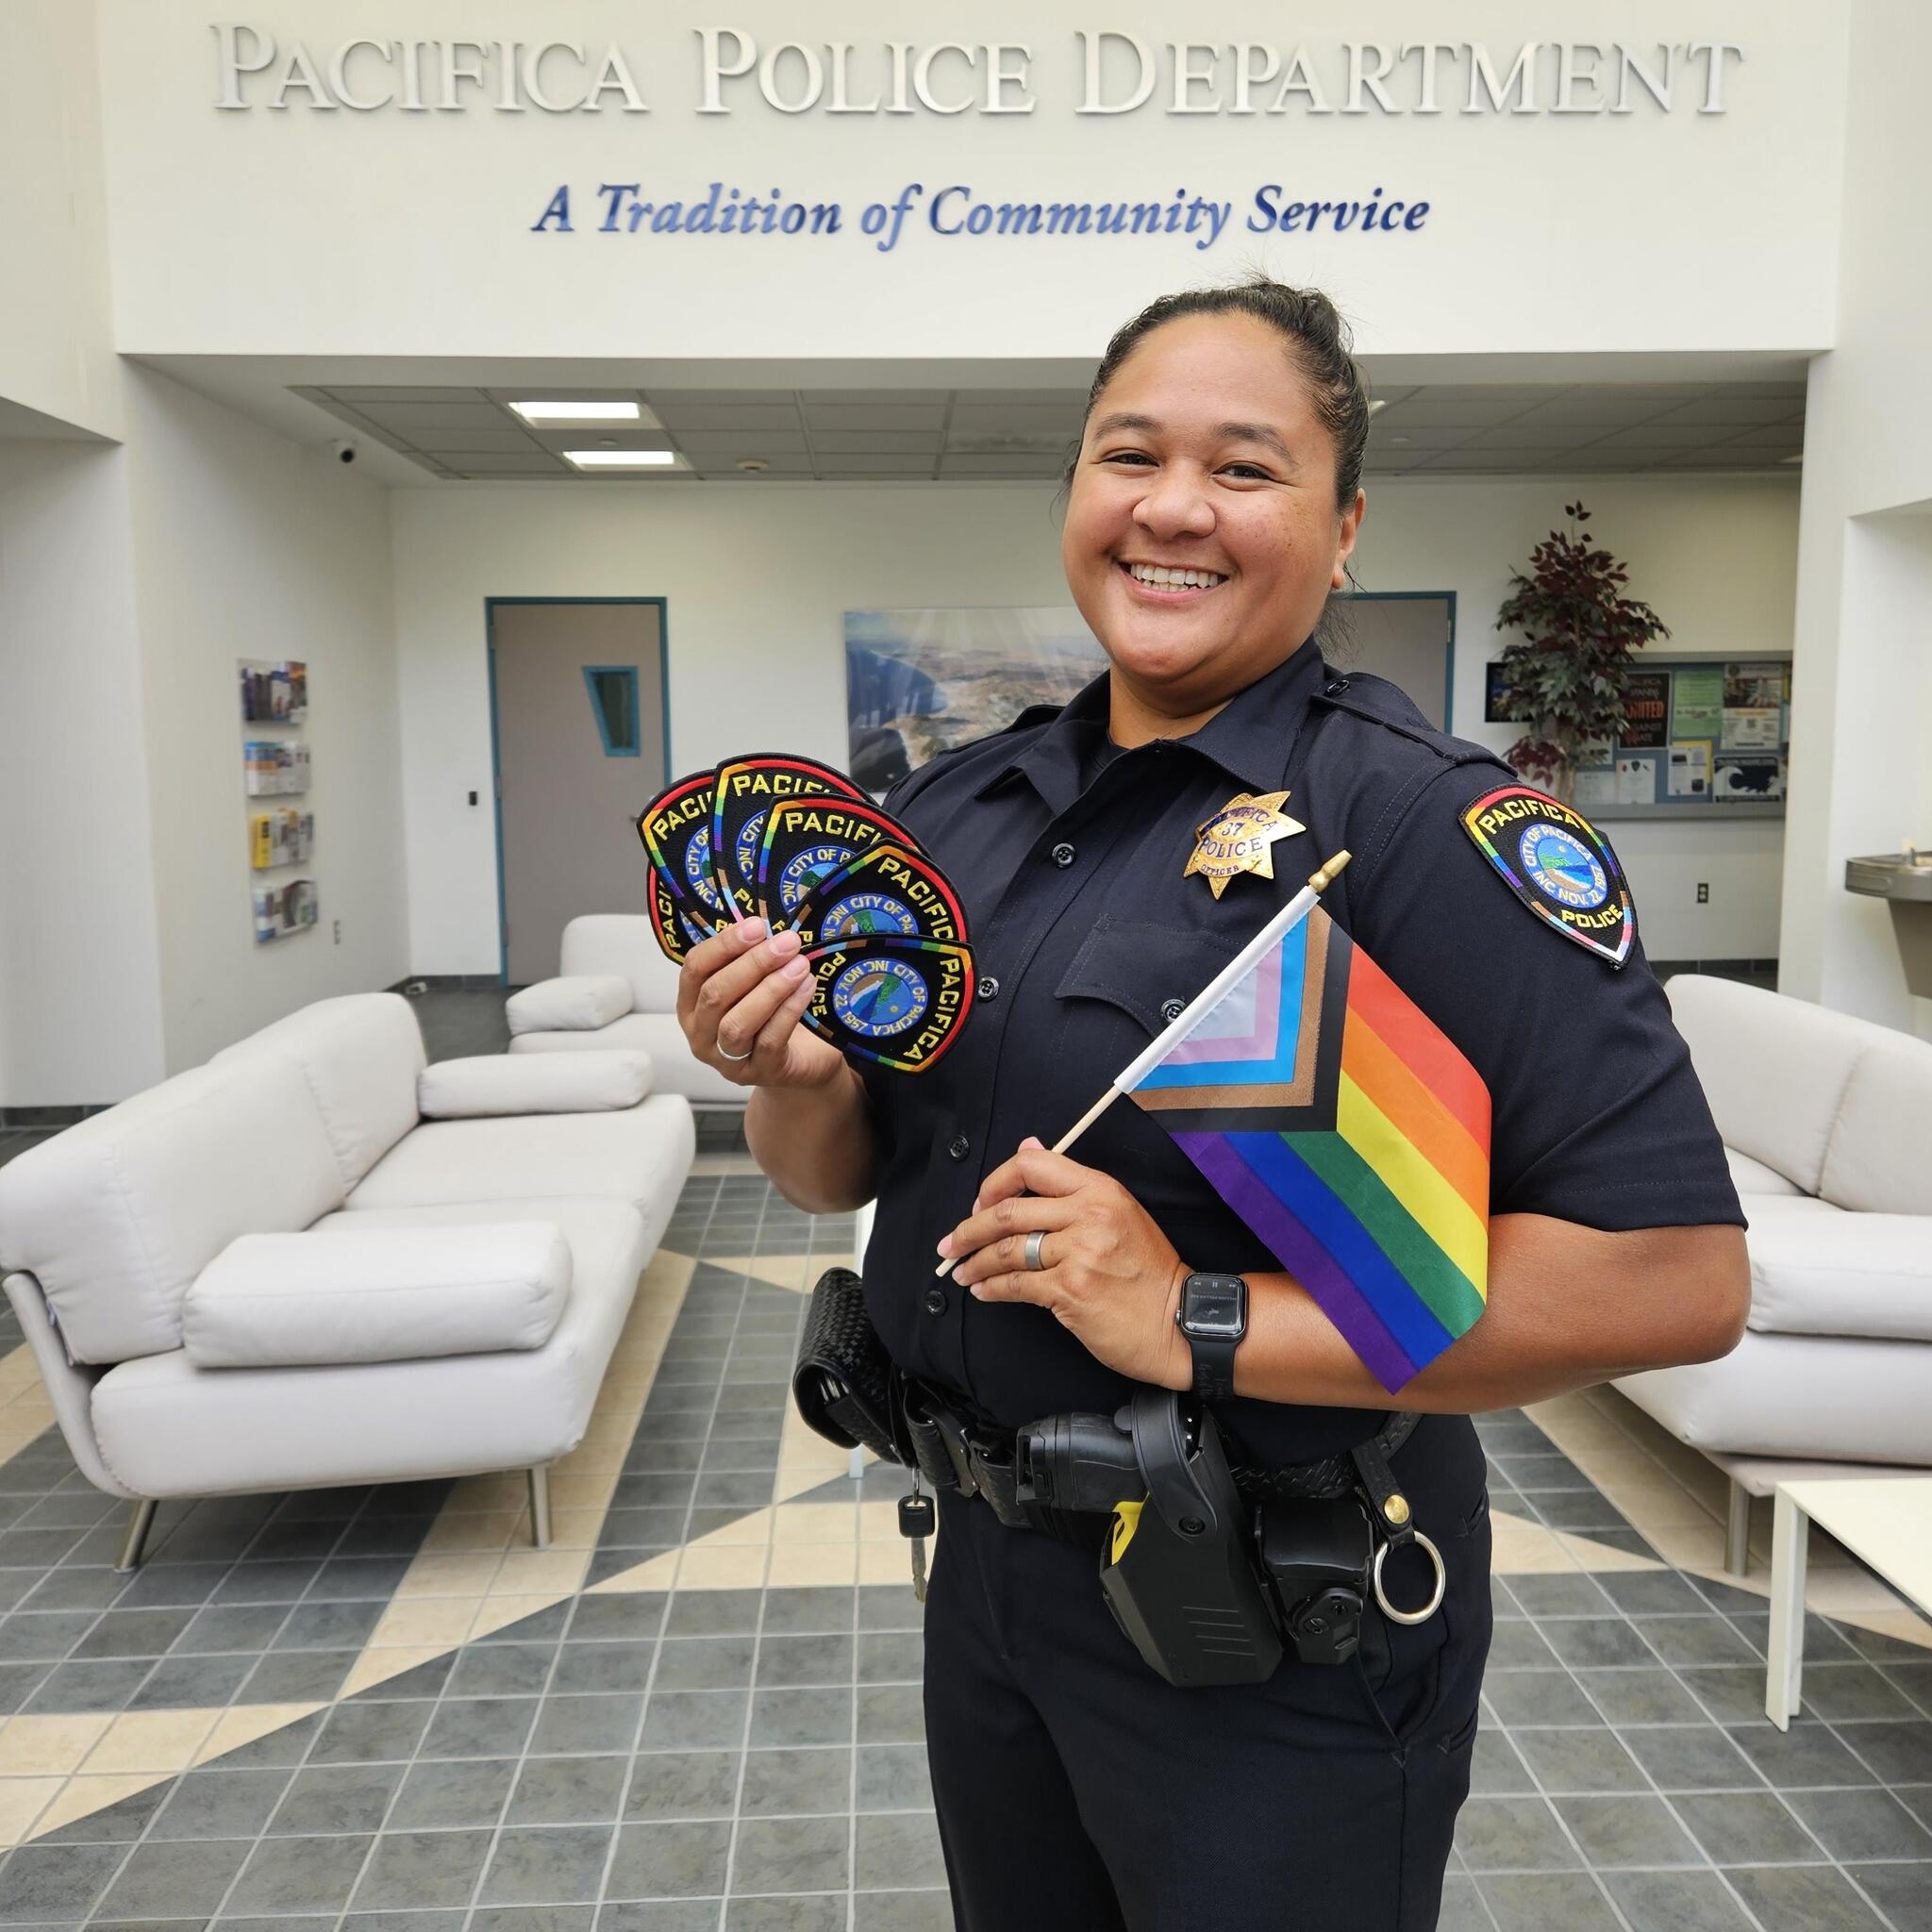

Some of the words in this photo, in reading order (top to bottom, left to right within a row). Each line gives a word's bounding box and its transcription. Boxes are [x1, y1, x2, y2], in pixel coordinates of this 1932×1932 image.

[209, 23, 651, 113] PACIFICA
[692, 26, 1036, 114] POLICE
[1074, 28, 1745, 116] DEPARTMENT
[531, 183, 575, 233] A
[597, 182, 842, 235] Tradition
[860, 183, 923, 252] of
[928, 186, 1232, 251] Community
[1246, 184, 1431, 234] Service
[732, 774, 831, 797] PACIF
[1478, 799, 1581, 835] PACIFICA
[1197, 834, 1263, 858] POLICE
[788, 852, 814, 877] CITY
[817, 848, 837, 861] OF
[658, 881, 682, 949] PACI
[850, 895, 882, 909] CITY
[883, 900, 903, 914] OF
[1561, 904, 1624, 929] POLICE
[811, 952, 847, 1018] POLICE
[893, 964, 920, 988] CITY
[903, 958, 961, 1060] PACIFICA
[911, 987, 925, 1003] OF
[872, 1004, 924, 1036] PACIFICA
